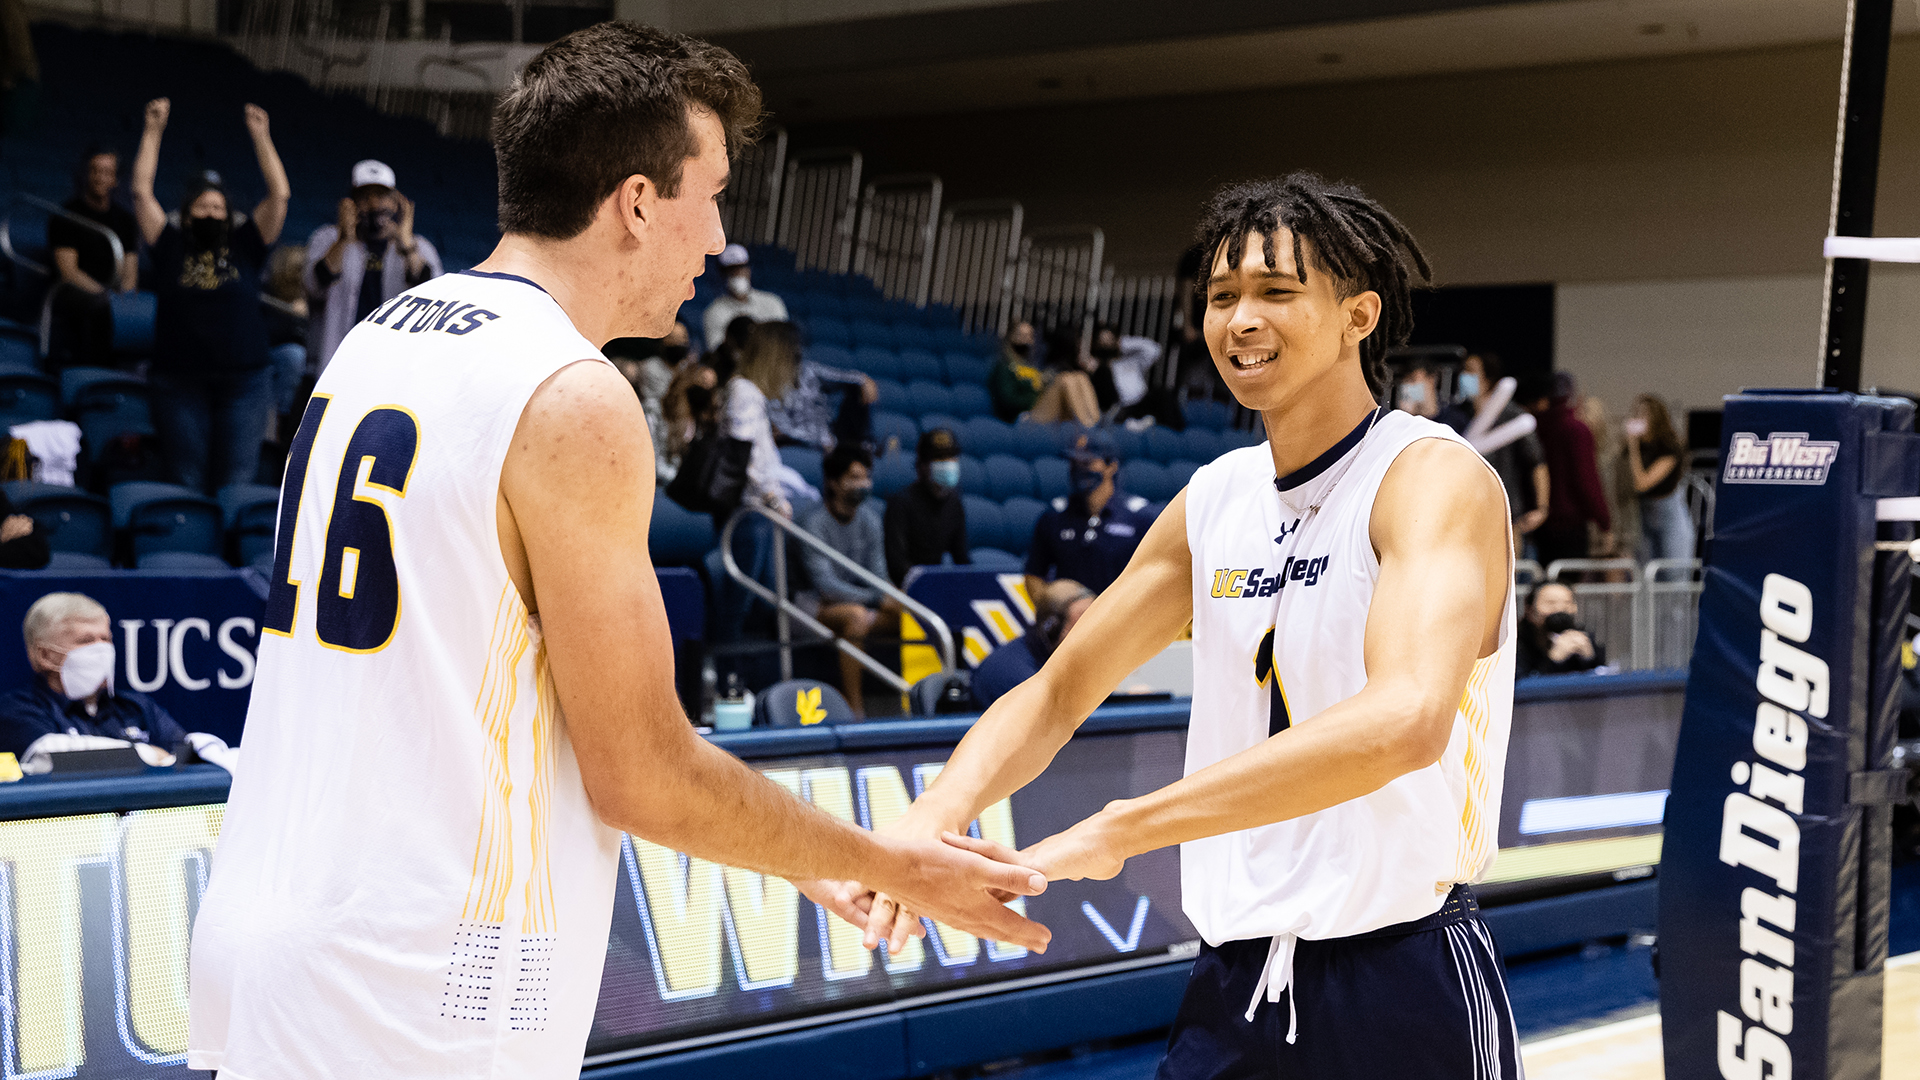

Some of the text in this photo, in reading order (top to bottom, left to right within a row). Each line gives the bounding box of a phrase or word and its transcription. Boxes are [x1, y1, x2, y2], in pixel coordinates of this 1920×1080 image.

[366, 294, 502, 336] ITONS
[1731, 437, 1833, 466] BIG WEST
[1728, 466, 1824, 480] CONFERENCE
[262, 392, 422, 655] 16
